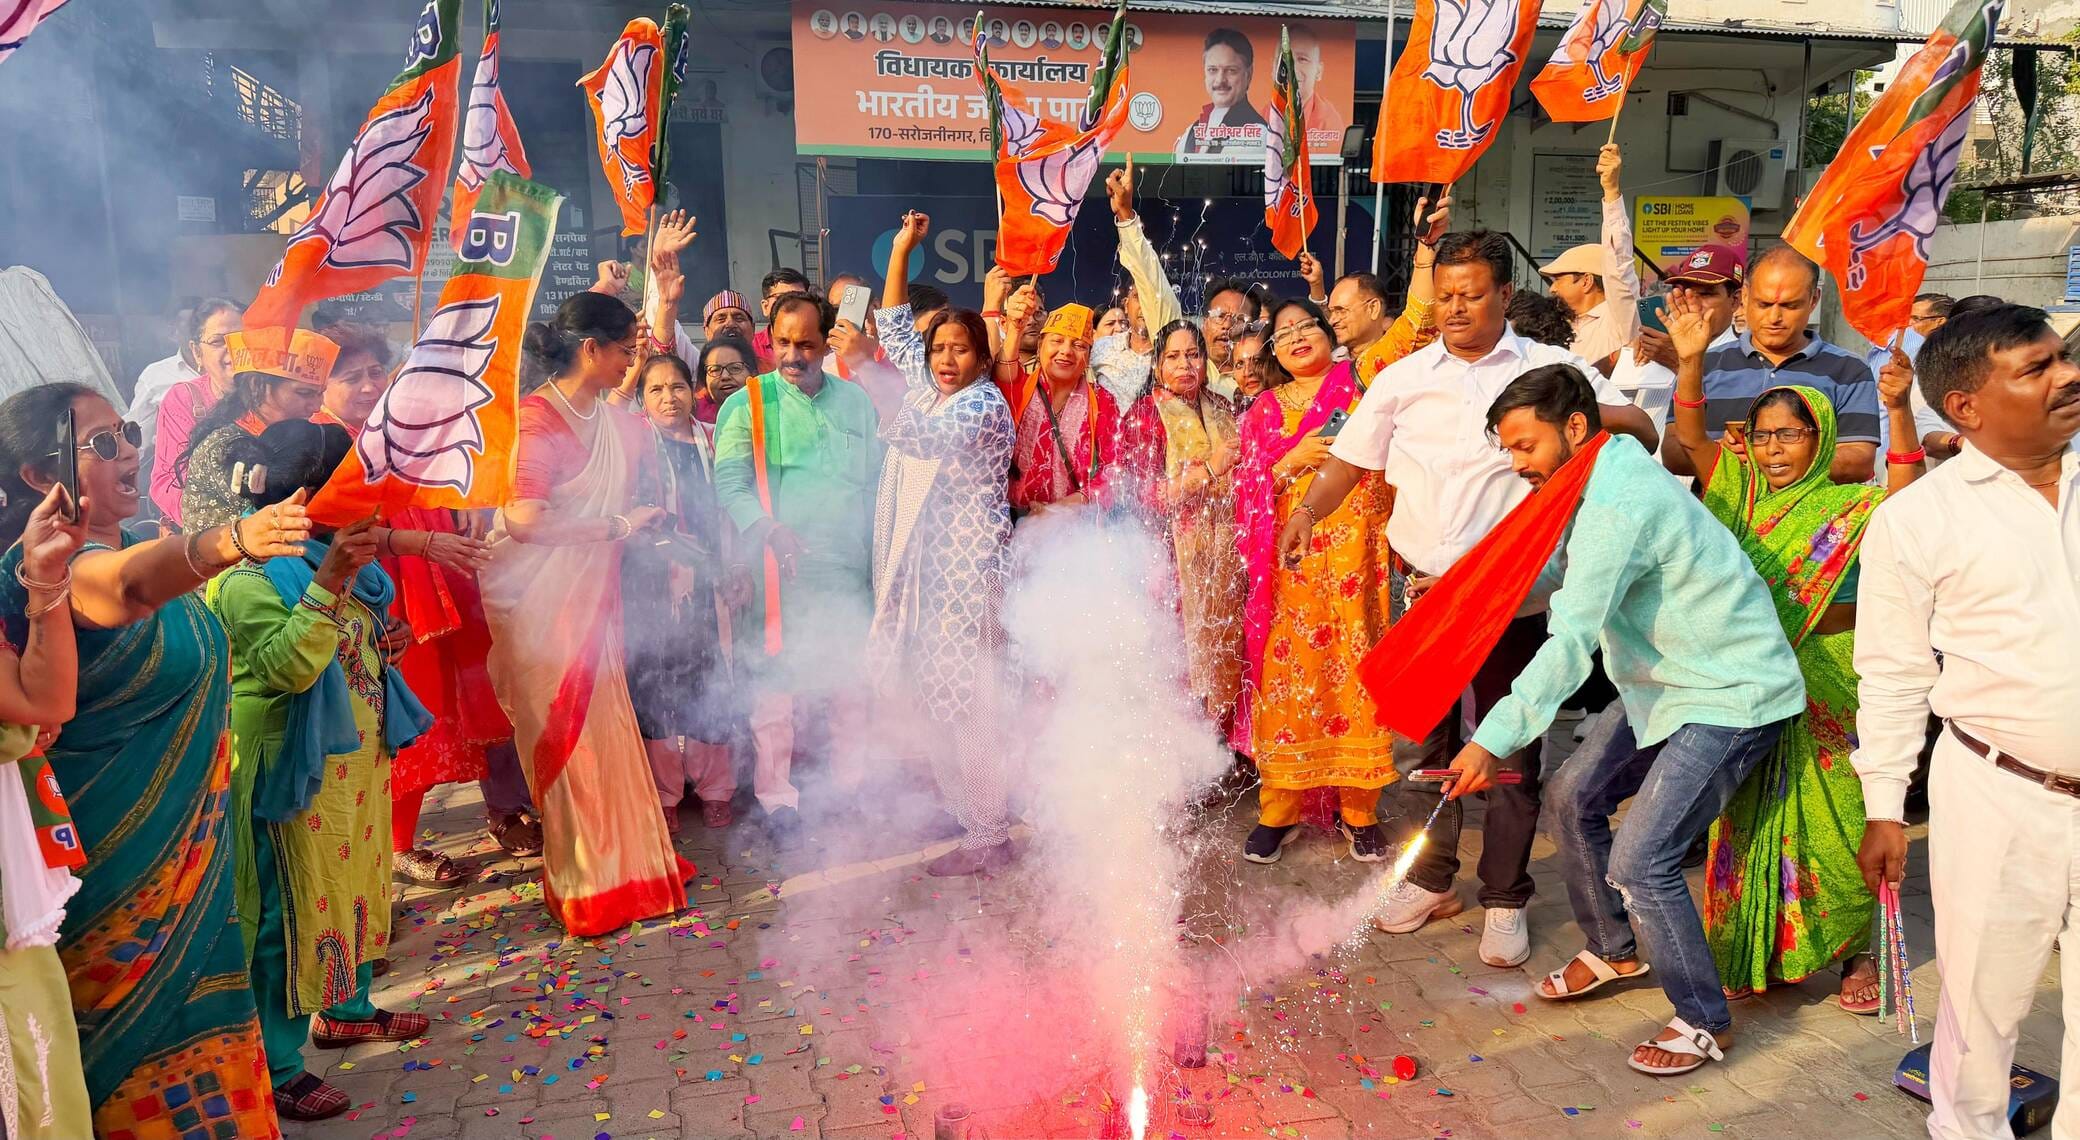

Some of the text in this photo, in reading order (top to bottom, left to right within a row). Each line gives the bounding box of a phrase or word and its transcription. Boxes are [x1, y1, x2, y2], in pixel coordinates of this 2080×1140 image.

[875, 50, 974, 79] विधायक
[856, 85, 959, 119] भारतीय
[868, 125, 976, 143] 170-सरोजनीनगर,
[1209, 124, 1242, 138] राजेश्वर
[1243, 124, 1262, 138] सिंह
[1653, 203, 1672, 215] SBI
[459, 208, 521, 267] B
[1257, 270, 1291, 279] COLONY
